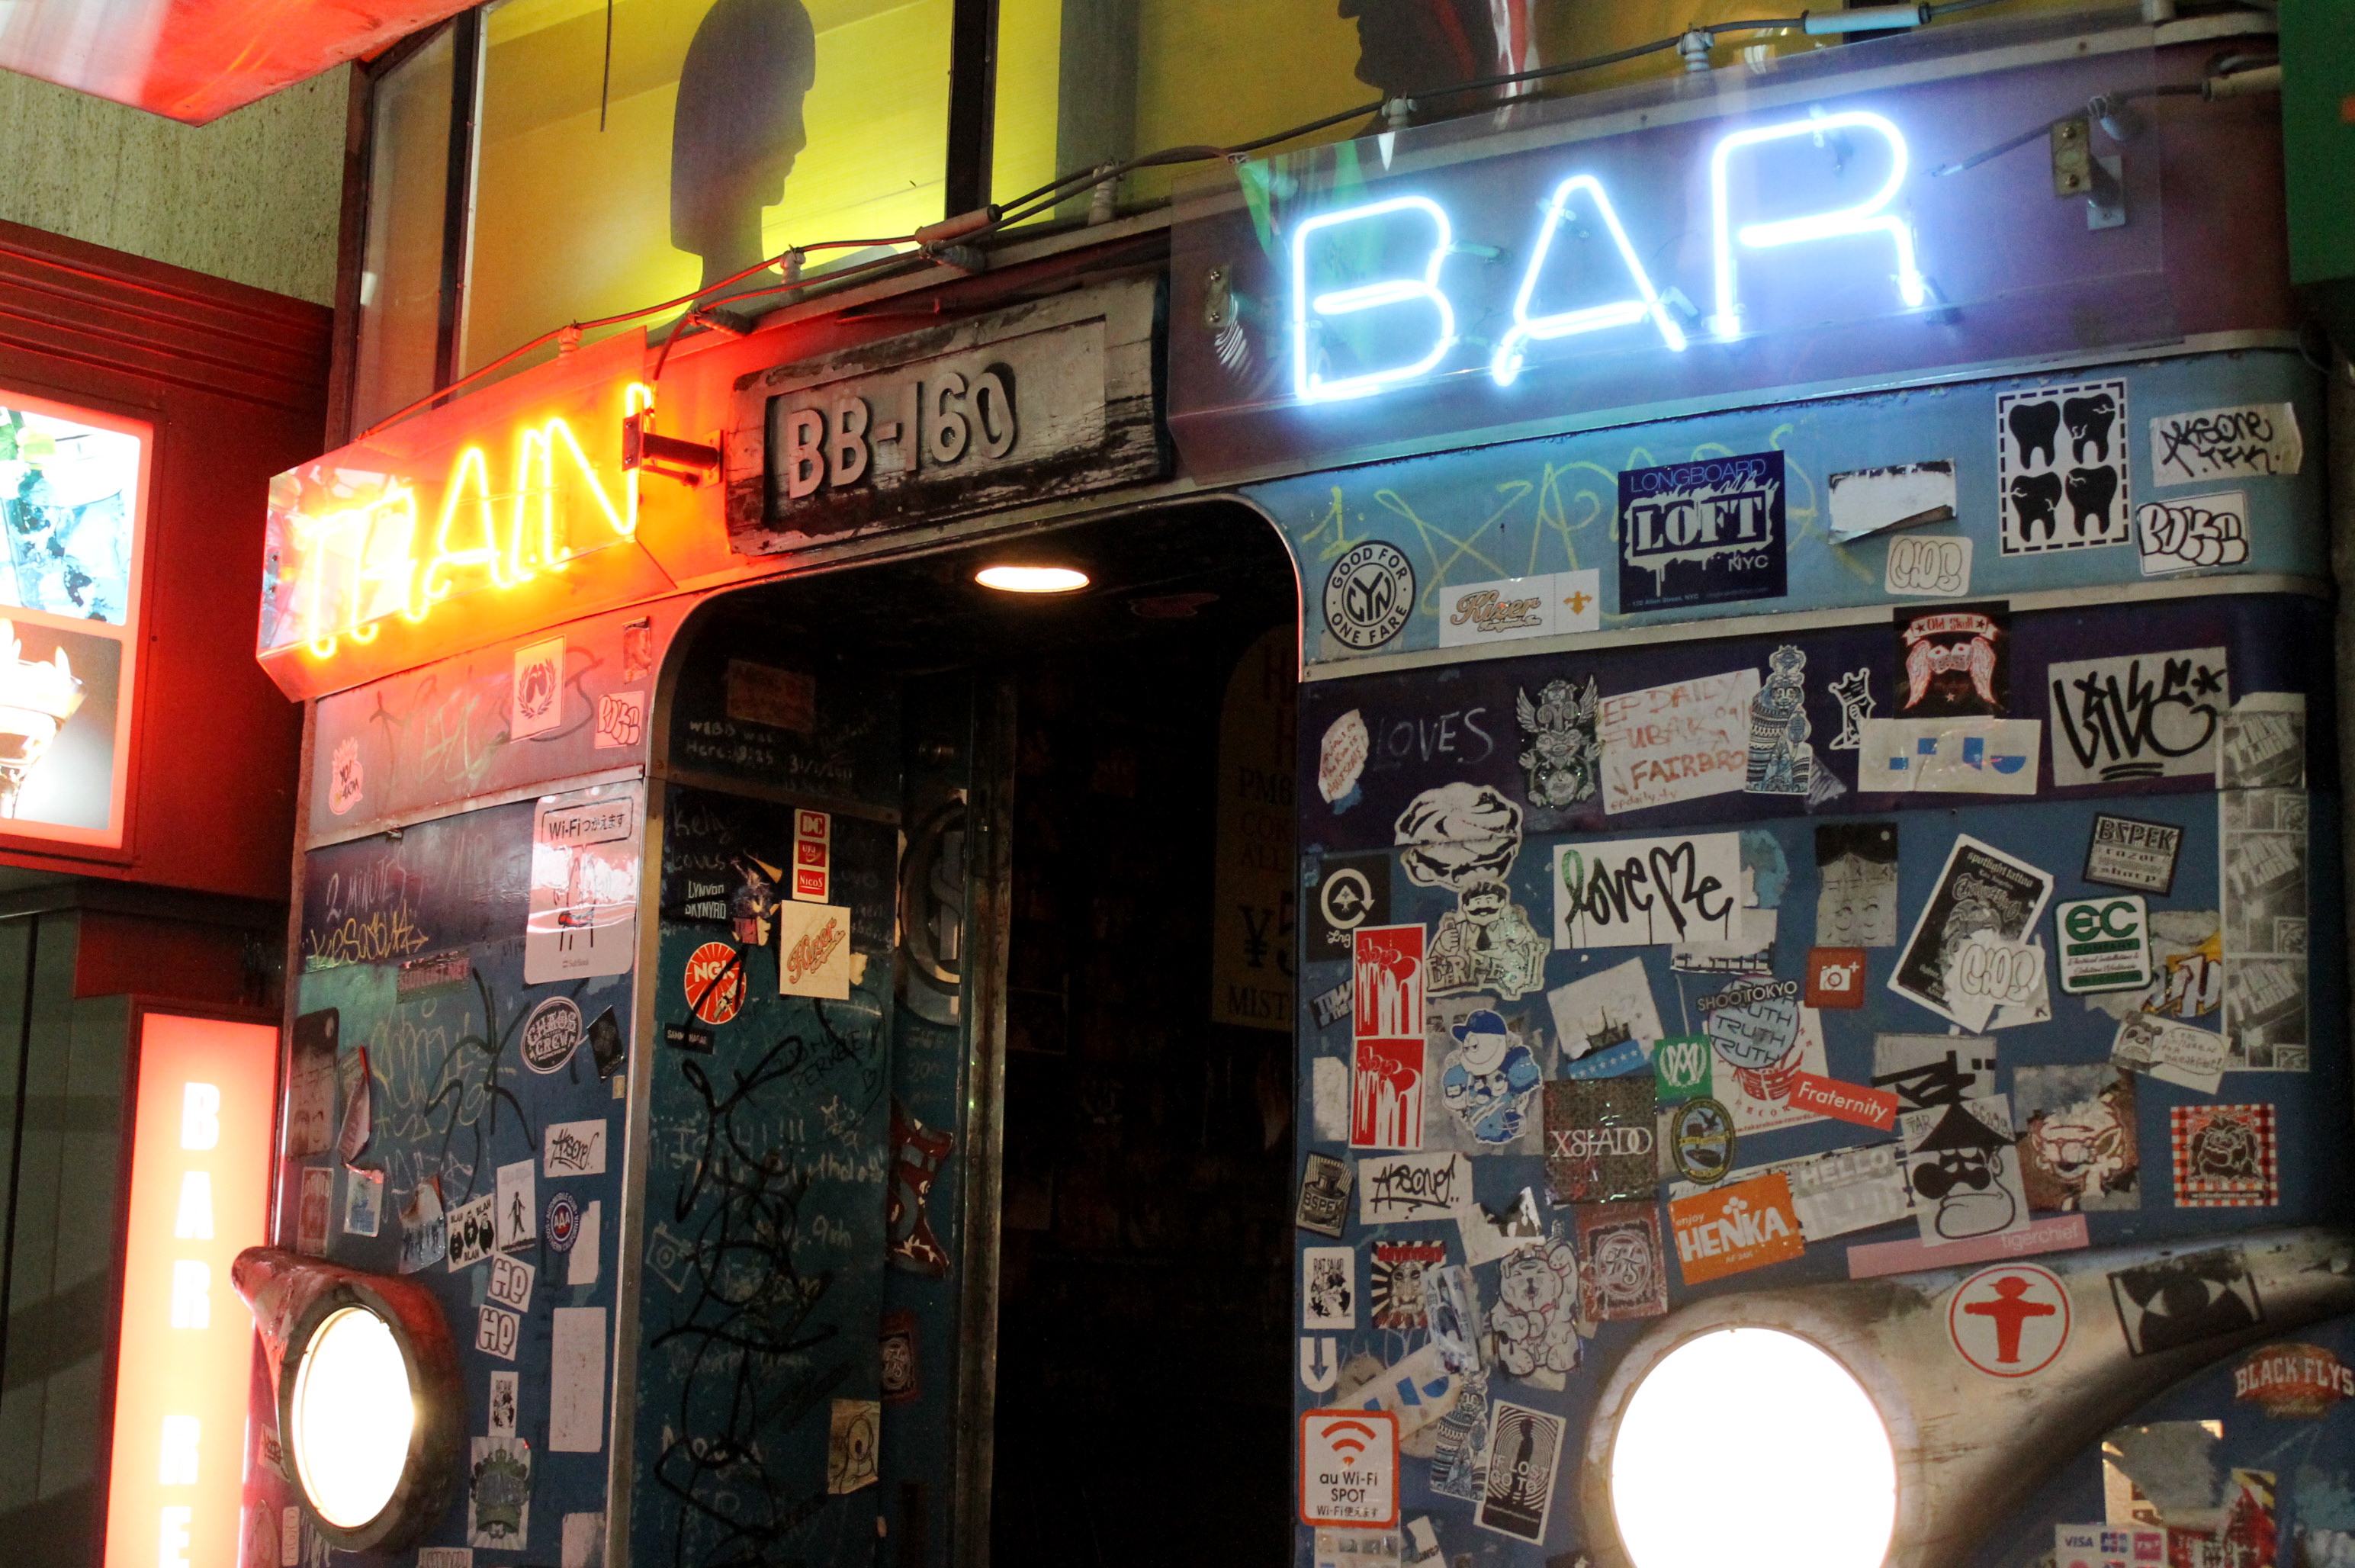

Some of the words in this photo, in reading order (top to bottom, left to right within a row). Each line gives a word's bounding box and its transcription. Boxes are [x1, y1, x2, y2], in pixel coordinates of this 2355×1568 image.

[1290, 108, 1926, 402] BAR
[788, 365, 1017, 500] BB-160
[1631, 459, 1765, 492] LONGBOARD
[299, 381, 651, 658] TRAIN
[1636, 496, 1762, 551] LOFT
[1332, 547, 1373, 590] GOOD
[1378, 547, 1409, 580] FOR
[1729, 555, 1769, 571] NYC
[1332, 612, 1361, 644] ONE
[1369, 605, 1408, 644] FARE
[1926, 617, 1945, 631] Old
[802, 815, 824, 836] DC
[2098, 819, 2174, 851] BSPEK
[1966, 851, 2010, 878] spotlight
[2007, 869, 2034, 888] tattoo
[693, 959, 736, 983] NGK
[526, 1009, 577, 1046] CHAOS
[667, 1030, 686, 1042] SAMM
[1716, 1014, 1786, 1048] TRUTH
[1710, 1033, 1780, 1064] TRUTH
[1798, 1081, 1889, 1123] Fraternity
[1800, 1149, 1890, 1186] HELLO
[171, 1081, 222, 1330] BAR
[1303, 1191, 1346, 1215] BSPEK
[554, 1211, 570, 1229] AAA
[1675, 1213, 1705, 1227] enjoy
[1677, 1200, 1791, 1263] HENKA
[2234, 1356, 2299, 1399] BLACK
[2303, 1357, 2355, 1397] FLYS
[1319, 1473, 1338, 1485] au
[1342, 1471, 1378, 1485] Wi-Fi
[1331, 1488, 1366, 1503] SPOT
[2064, 1535, 2094, 1548] VISA
